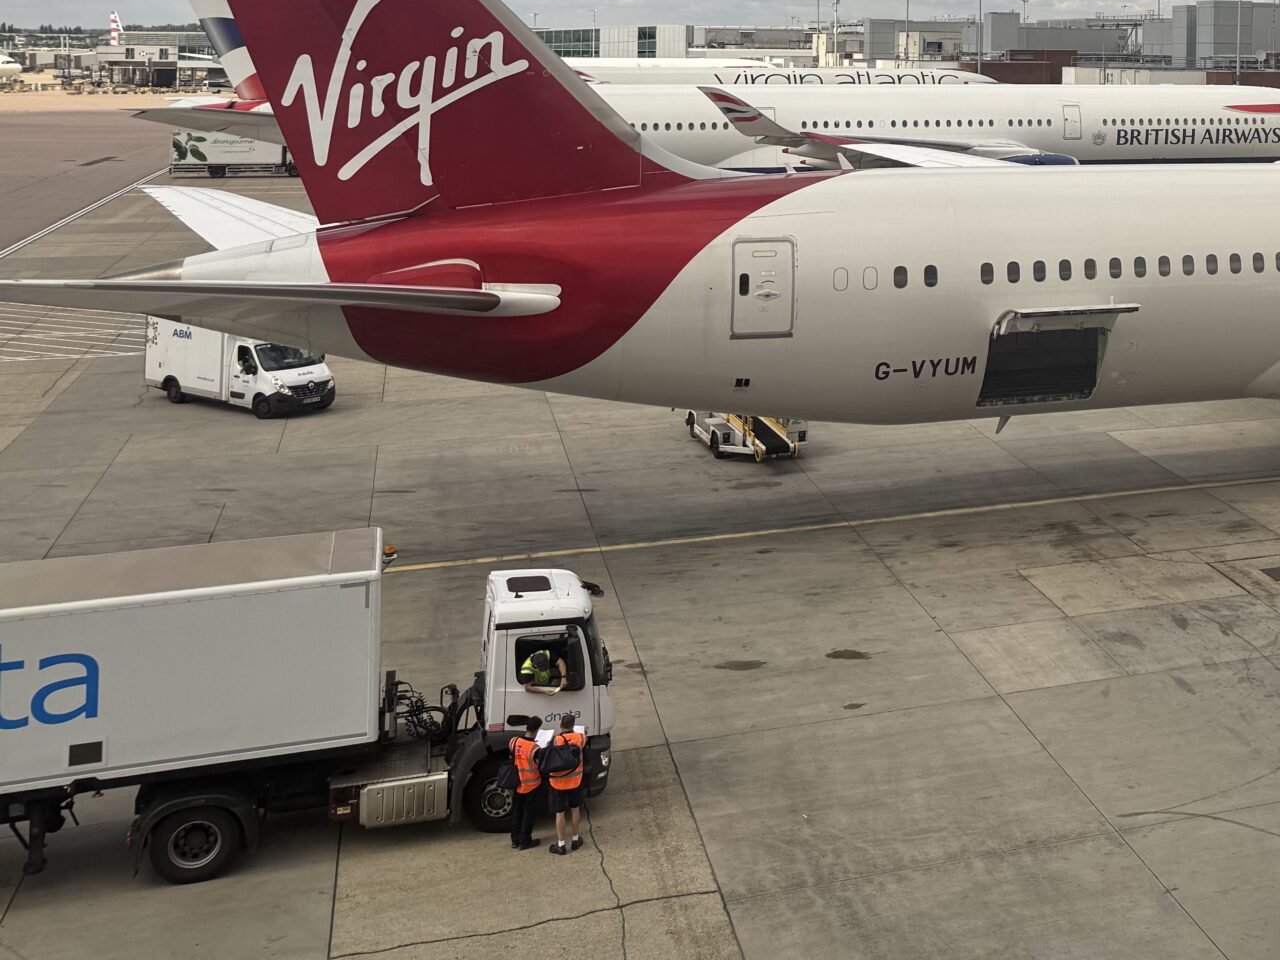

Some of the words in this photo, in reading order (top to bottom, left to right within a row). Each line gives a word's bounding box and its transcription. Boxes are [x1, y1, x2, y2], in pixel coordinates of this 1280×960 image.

[1116, 129, 1196, 145] BRITISH
[172, 328, 193, 340] ABM
[874, 356, 977, 381] G-VYUM
